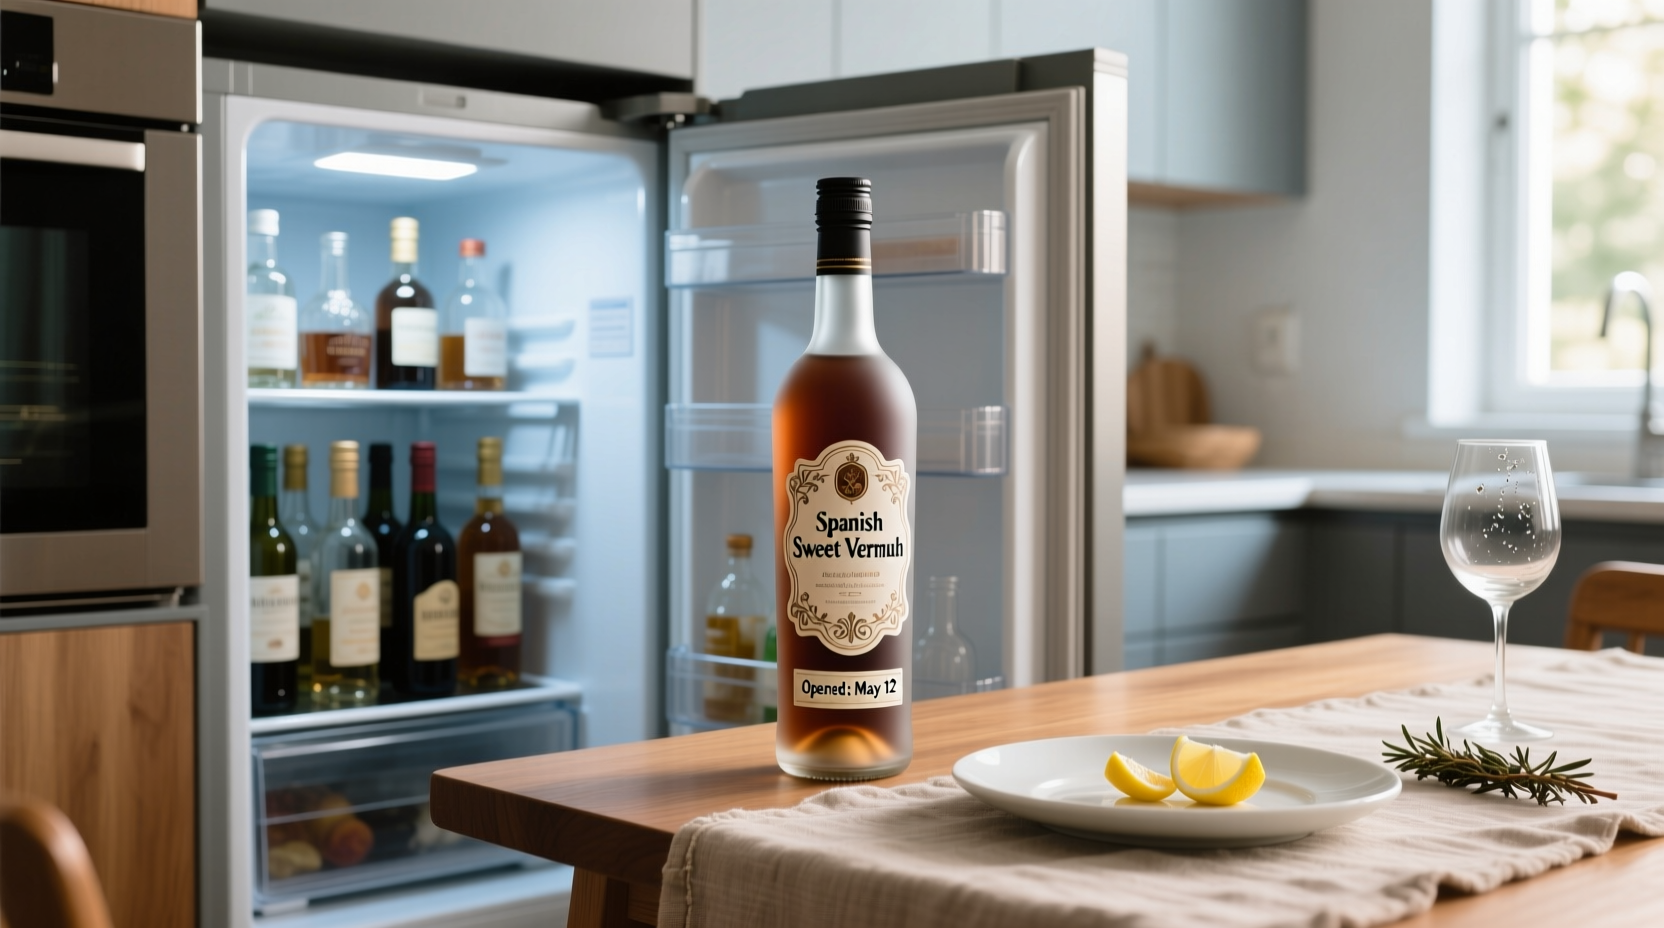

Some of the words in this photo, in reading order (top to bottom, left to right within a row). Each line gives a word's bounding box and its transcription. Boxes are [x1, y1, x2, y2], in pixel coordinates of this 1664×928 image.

[815, 511, 883, 538] Spanish
[792, 536, 841, 559] Sweet
[844, 536, 904, 558] Vermuh
[801, 679, 851, 699] Opened:
[854, 680, 881, 698] May
[883, 678, 897, 694] 12
